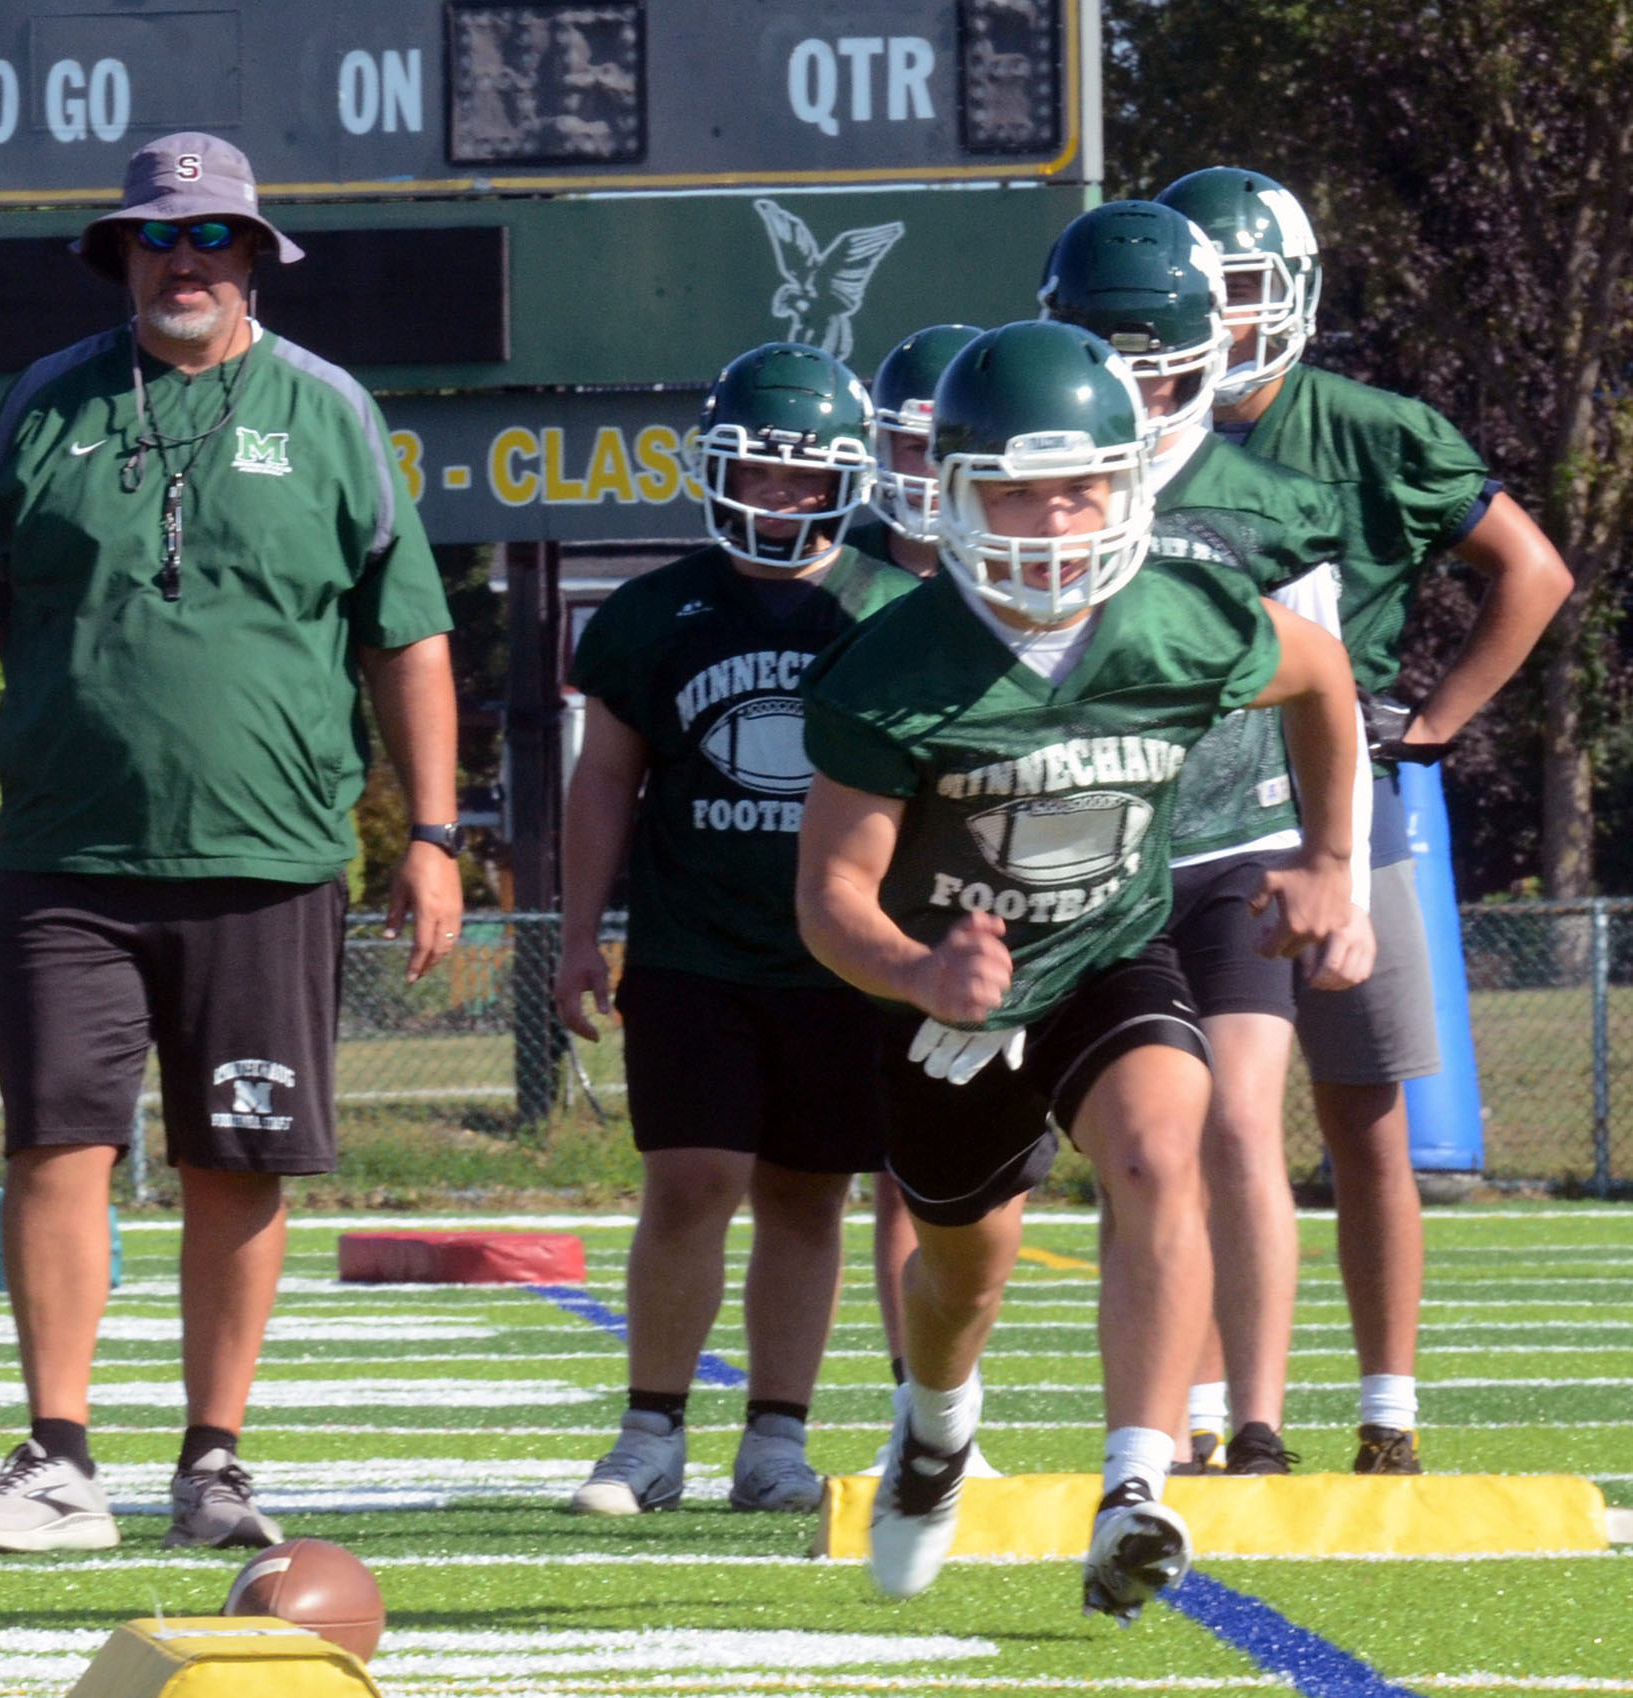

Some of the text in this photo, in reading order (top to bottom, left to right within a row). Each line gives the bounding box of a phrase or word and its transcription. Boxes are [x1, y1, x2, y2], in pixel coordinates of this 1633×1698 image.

[46, 57, 131, 142] GO
[339, 49, 422, 135] ON
[788, 36, 936, 137] QTR
[176, 153, 203, 182] S
[235, 426, 289, 466] M
[675, 650, 817, 732] MINNEC
[692, 799, 805, 833] FOOTB
